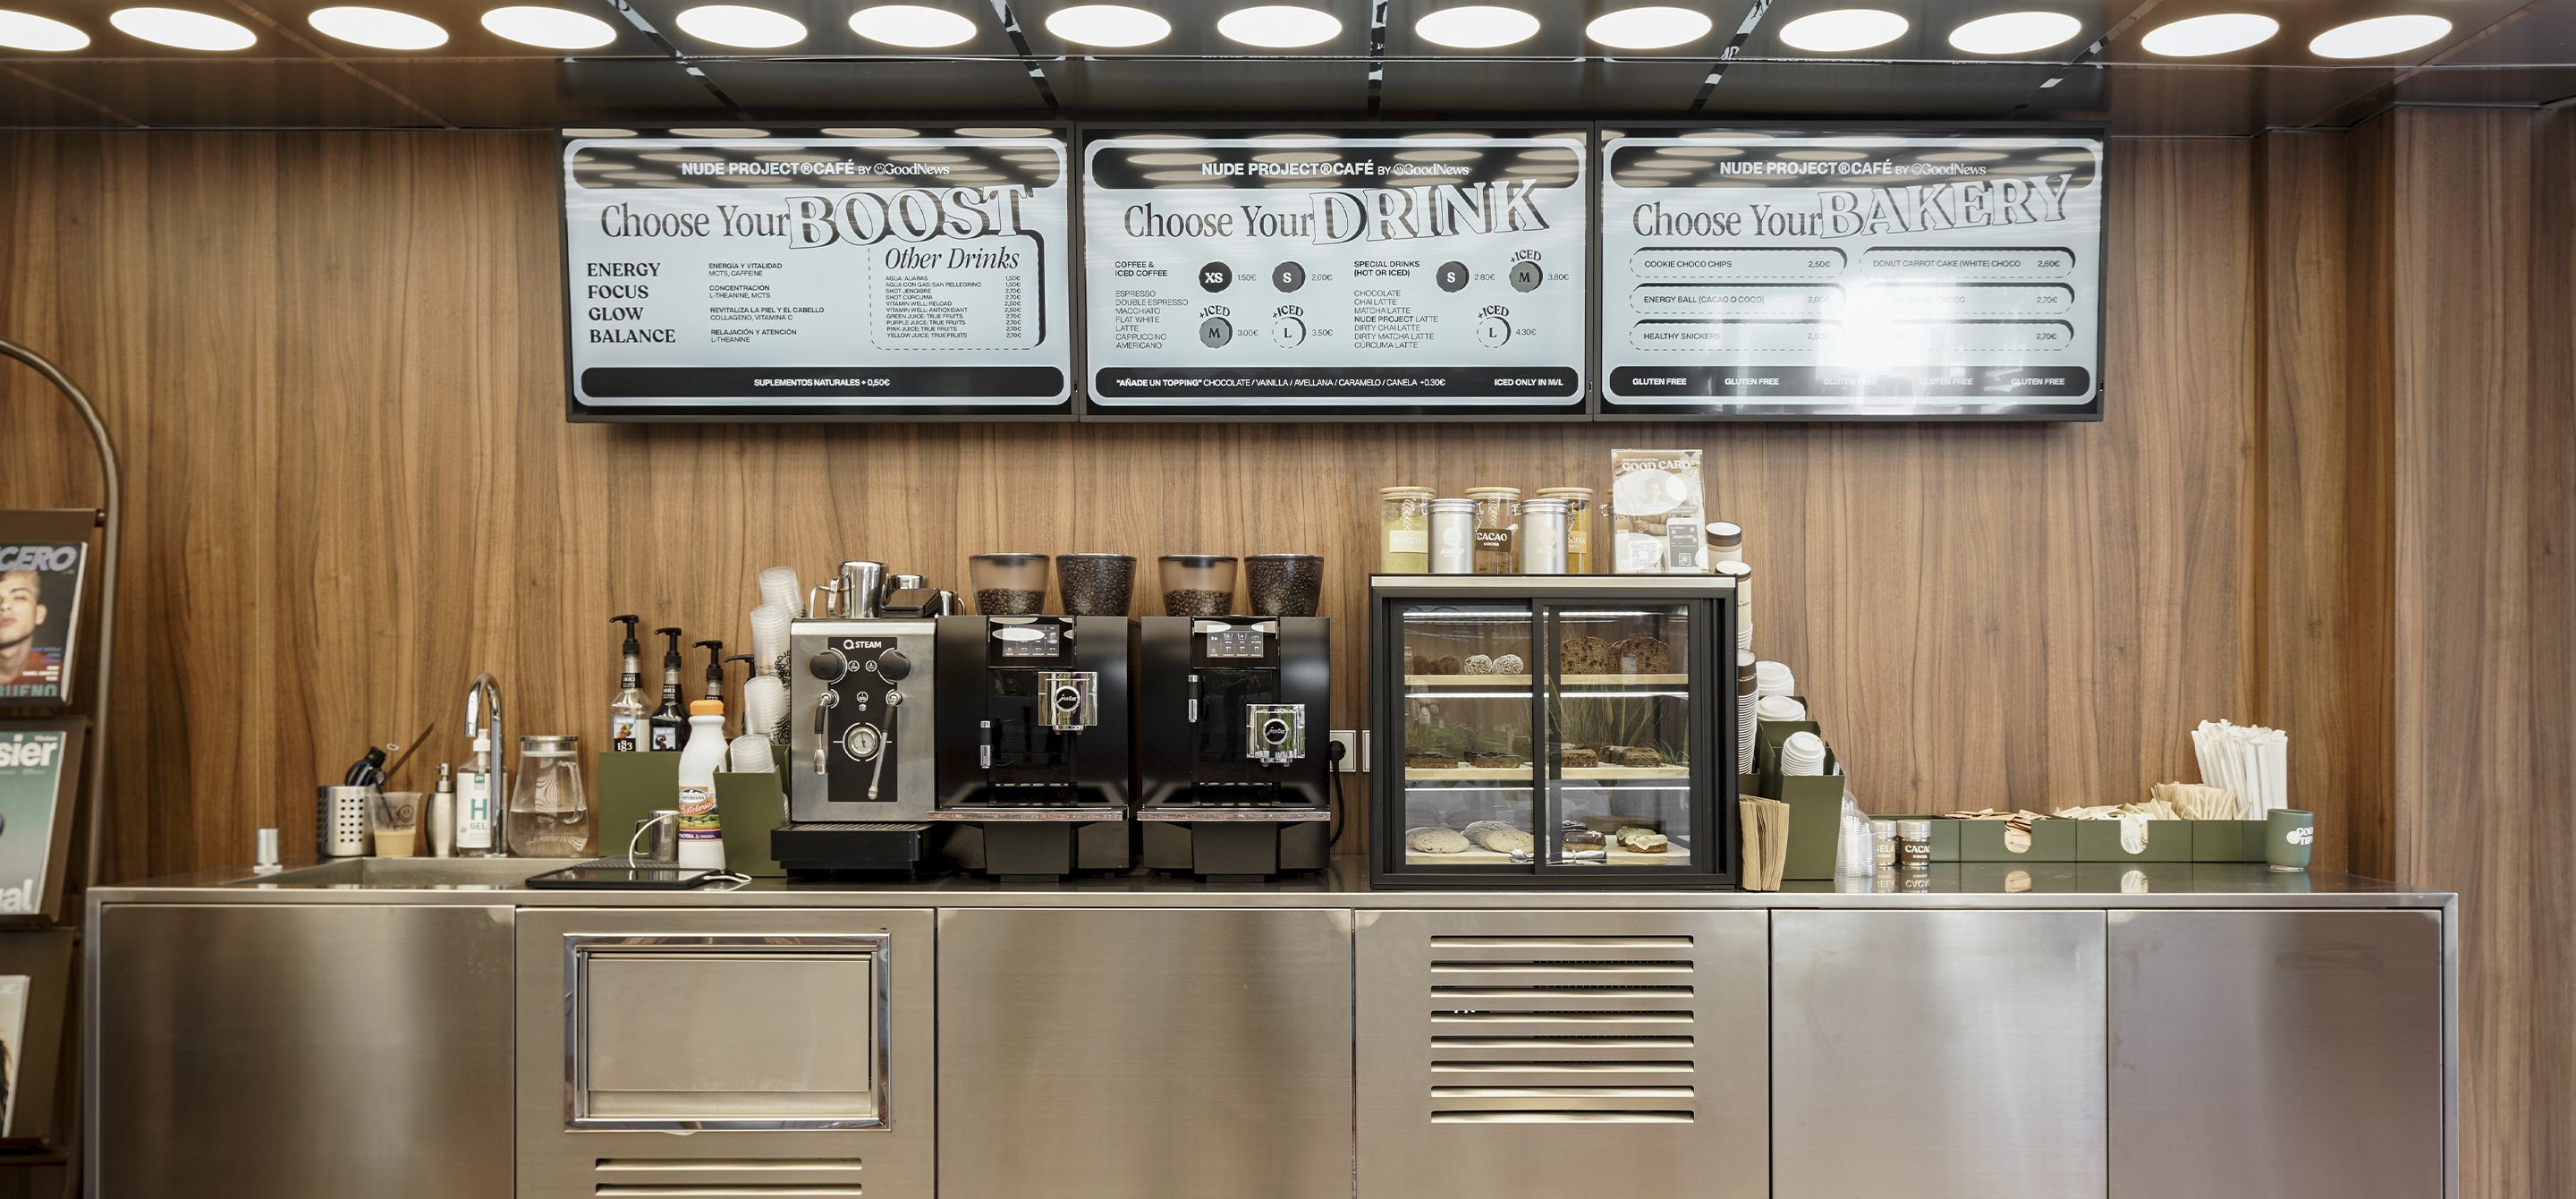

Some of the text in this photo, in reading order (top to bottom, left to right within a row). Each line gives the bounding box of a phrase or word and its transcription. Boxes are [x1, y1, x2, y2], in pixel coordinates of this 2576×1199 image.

[682, 163, 724, 175] NUDE
[858, 166, 871, 175] BY
[886, 163, 950, 175] GoodNews
[1202, 163, 1244, 175] NUDE
[1377, 166, 1391, 175] BY
[1404, 163, 1470, 175] GoodNews
[1720, 162, 1763, 174] NUDE
[1895, 166, 1910, 174] BY
[1922, 162, 1987, 174] GoodNews
[1124, 178, 1549, 245] Choose Your DRINK
[1632, 174, 2072, 240] Choose Your BAKERY
[601, 184, 1033, 250] Choose Your BOOST
[885, 246, 1020, 269] Other Drinks
[1809, 260, 1831, 268] 2,50€
[1873, 259, 1902, 268] DONUT
[1902, 259, 1936, 268] CARROT
[1936, 259, 1959, 268] CAKE
[1959, 259, 1990, 268] (WHITE)
[1991, 259, 2021, 268] CHOCO
[587, 263, 661, 277] ENERGY
[1354, 269, 1374, 277] (HOT
[1388, 269, 1411, 277] ICED)
[1205, 272, 1224, 283] XS
[1284, 272, 1292, 283] S
[1447, 272, 1456, 283] S
[1519, 272, 1530, 283] M
[588, 285, 648, 299] FOCUS
[1354, 298, 1397, 306] CHAI LATTE
[1699, 295, 1729, 305] (CACAO
[2037, 296, 2058, 304] 2,70€
[589, 307, 644, 321] GLOW
[590, 328, 676, 343] BALANCE
[1208, 327, 1220, 338] M
[1284, 327, 1292, 338] L
[1488, 327, 1497, 338] L
[2036, 333, 2057, 341] 2,70€
[1354, 340, 1394, 349] CÚRCUMA
[754, 378, 890, 387] SUPLEMENTOS NATURALES 0,50€
[1632, 378, 1687, 386] GLUTEN FREE
[1724, 378, 1780, 386] GLUTEN FREE
[1919, 378, 1974, 386] GLUTEN FREE
[2011, 378, 2065, 386] GLUTEN FREE
[1622, 460, 1691, 472] GOOD CARD
[1476, 531, 1508, 542] CACAO
[0, 546, 77, 572] CERO
[470, 798, 487, 821] H
[0, 879, 32, 913] al
